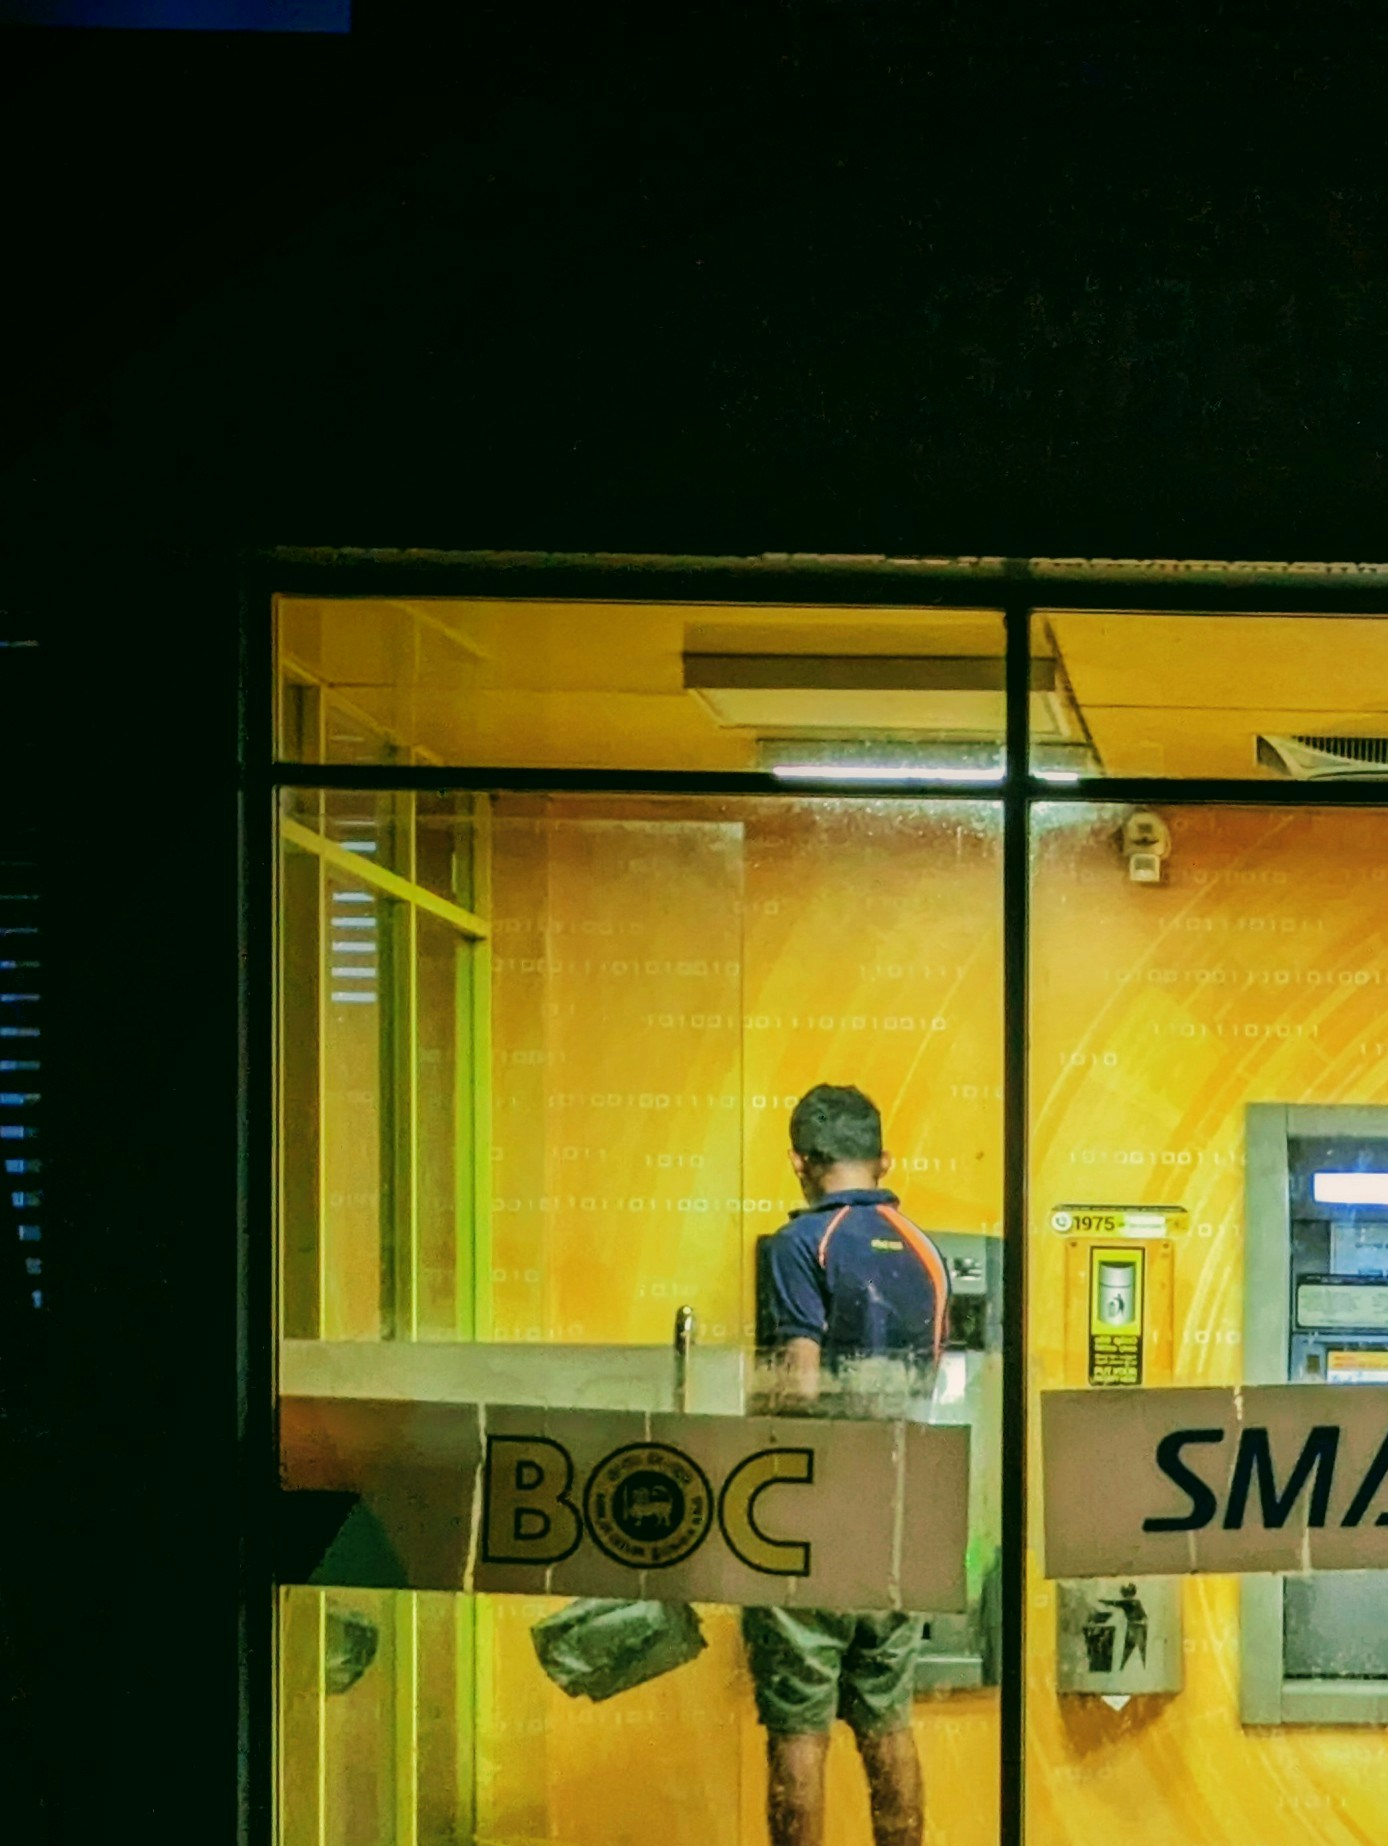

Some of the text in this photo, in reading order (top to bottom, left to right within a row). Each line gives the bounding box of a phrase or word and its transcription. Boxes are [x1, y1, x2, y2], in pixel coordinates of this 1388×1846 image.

[1152, 1023, 1318, 1038] 11011101011
[1058, 1051, 1118, 1066] 1010
[645, 1153, 705, 1167] 1010
[1073, 1215, 1116, 1231] 1975
[483, 1435, 814, 1577] BOC
